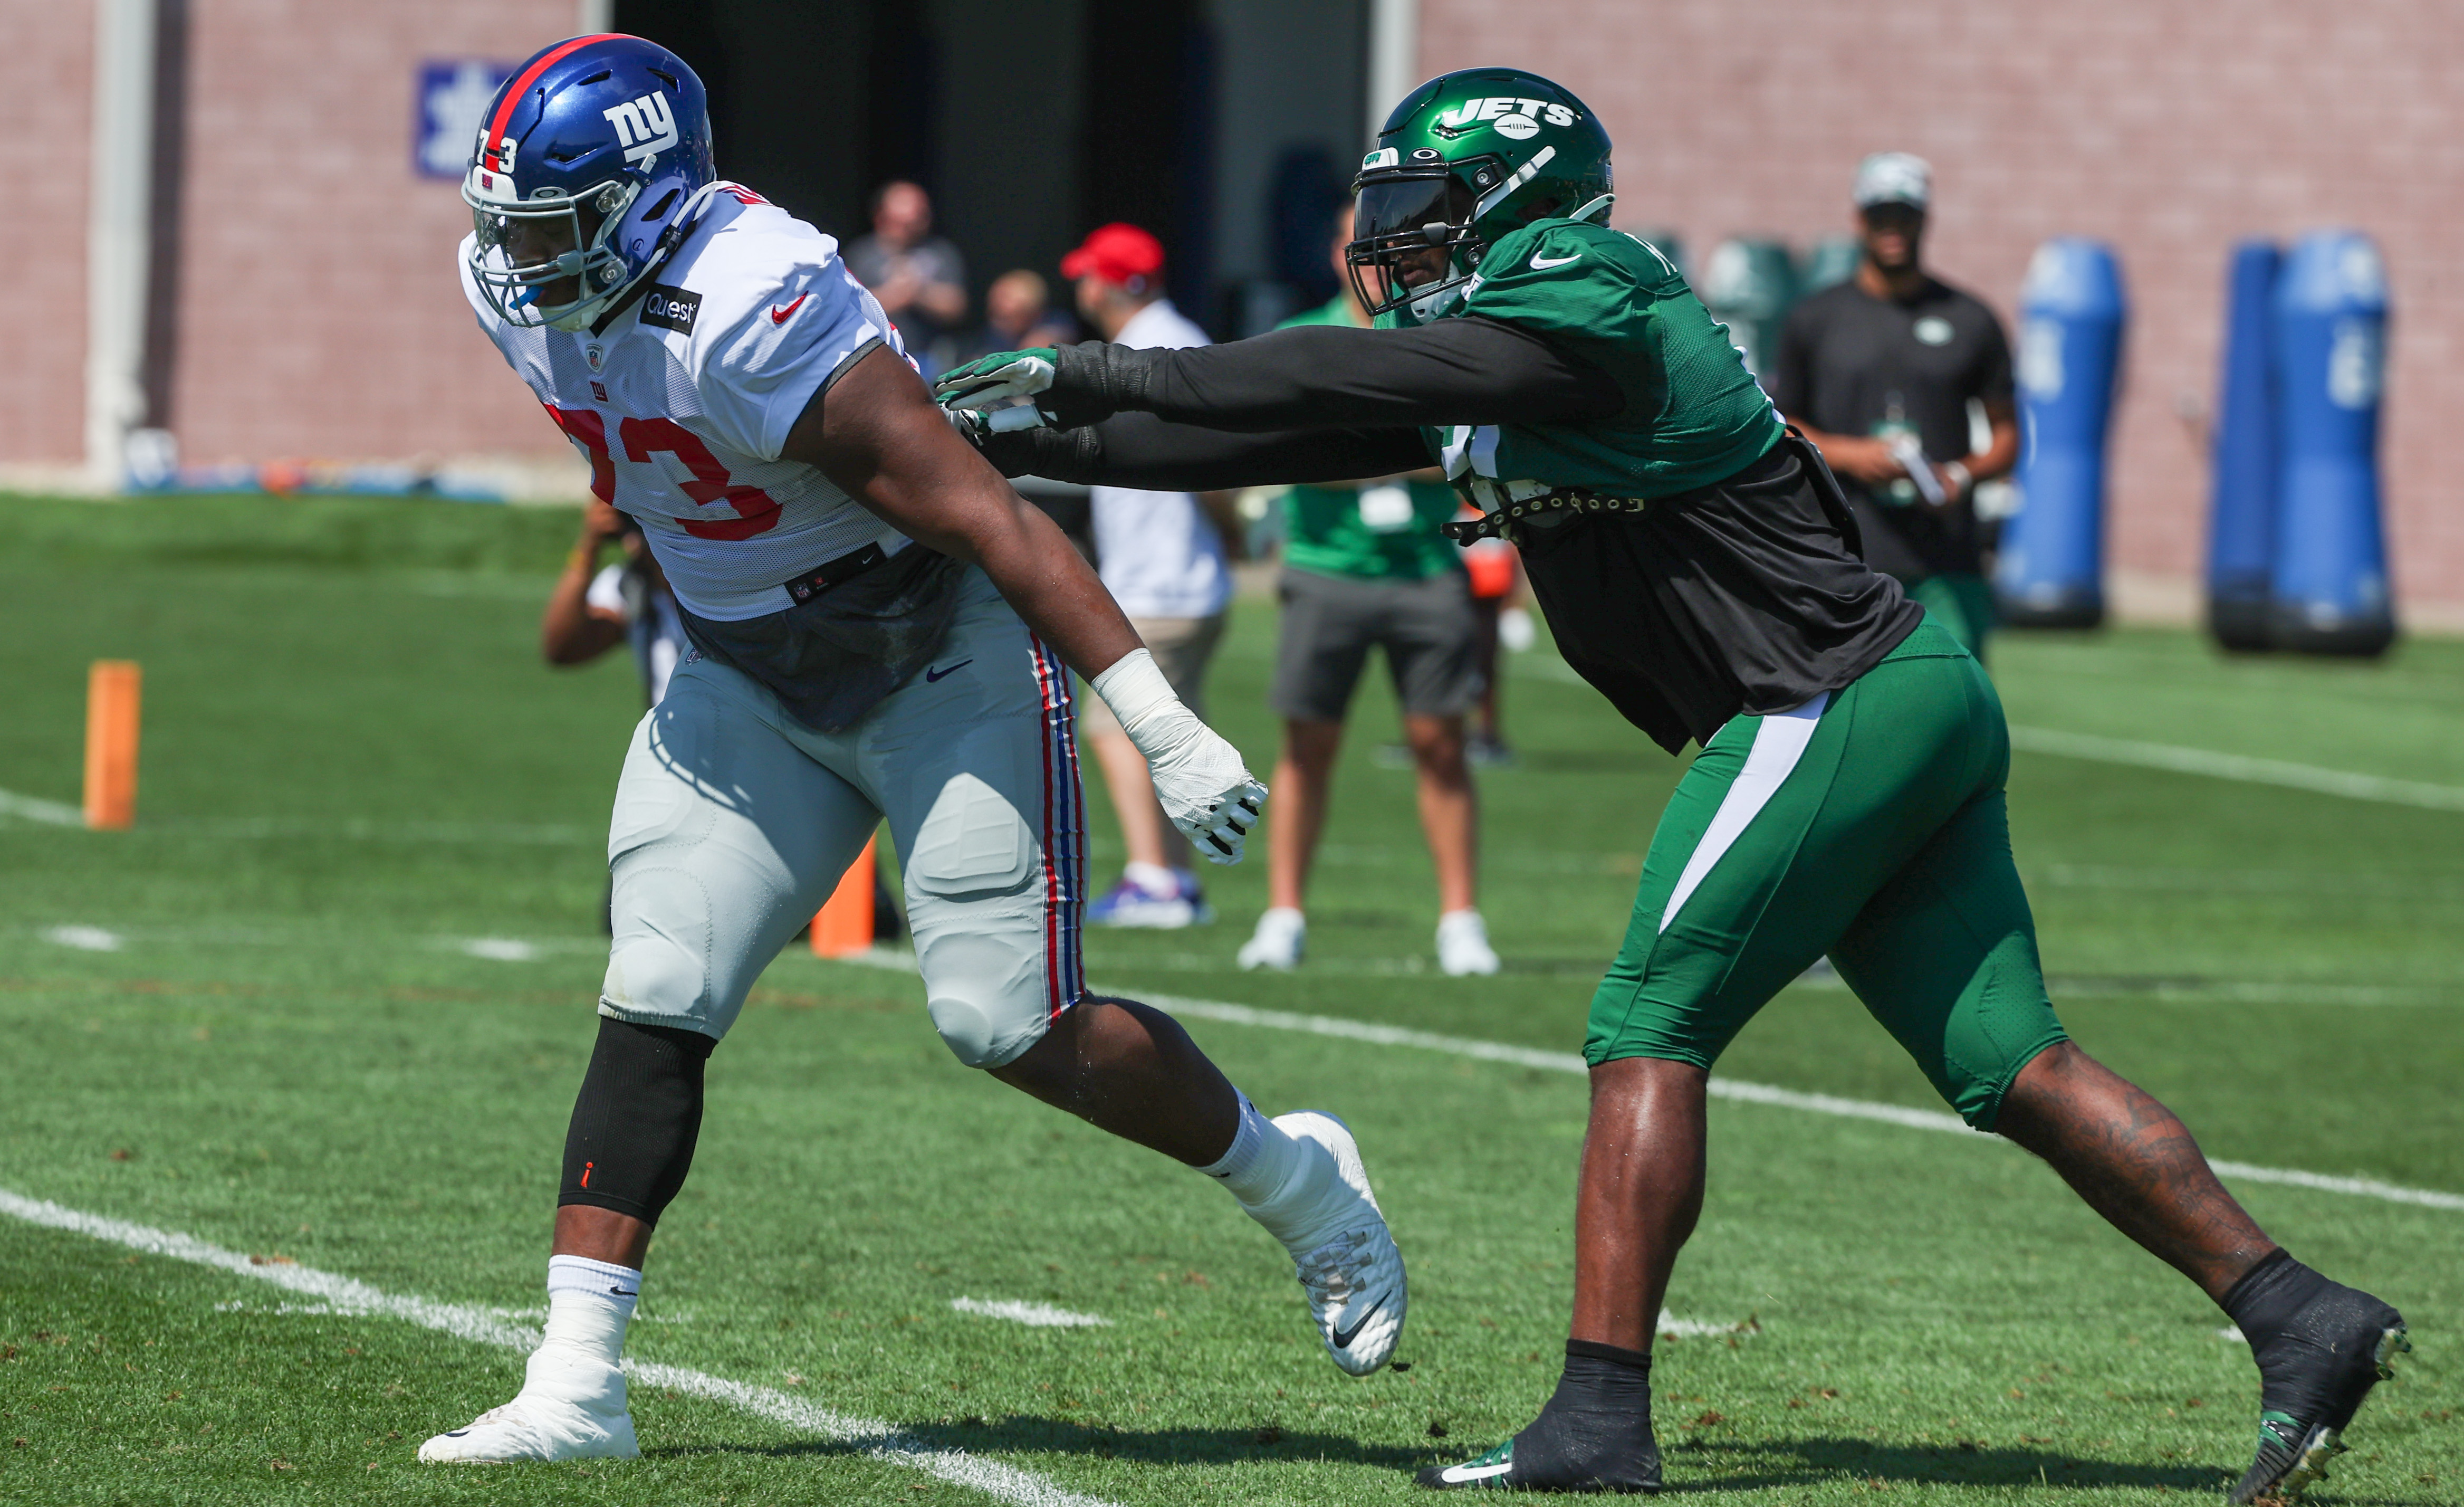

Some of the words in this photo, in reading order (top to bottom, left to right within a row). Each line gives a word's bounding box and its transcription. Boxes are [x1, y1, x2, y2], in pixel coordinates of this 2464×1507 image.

[1443, 98, 1574, 127] JETS
[477, 128, 517, 174] 73
[647, 293, 696, 323] Quest
